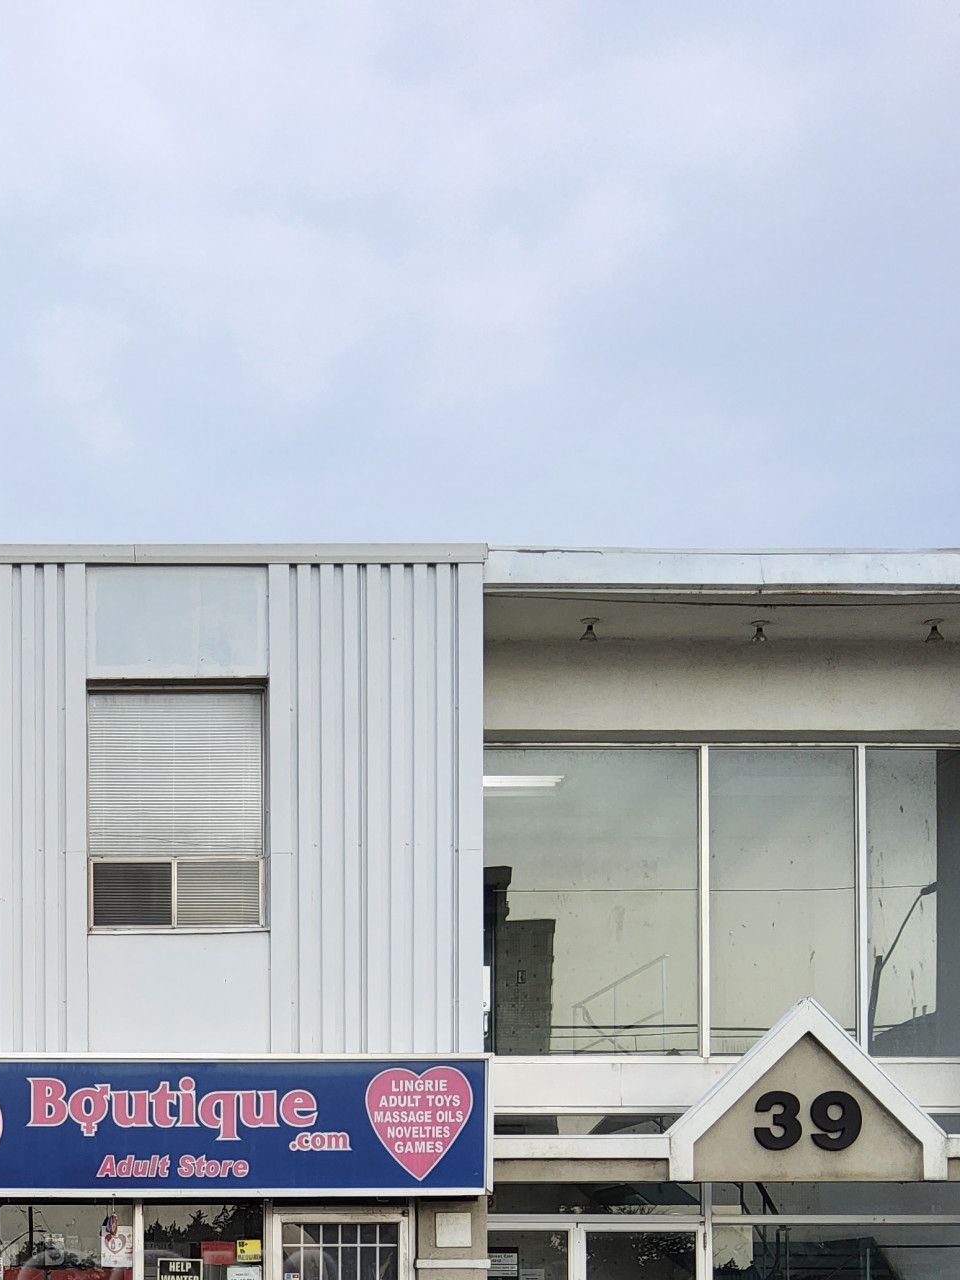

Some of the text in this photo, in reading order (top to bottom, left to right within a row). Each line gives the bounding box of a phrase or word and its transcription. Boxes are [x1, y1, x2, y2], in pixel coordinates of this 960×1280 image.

[391, 1079, 448, 1092] LINGRIE
[379, 1094, 461, 1108] ADULT TOYS
[25, 1075, 320, 1142] Boutique
[373, 1110, 464, 1124] MASSAGE OILS
[753, 1090, 863, 1151] 39
[387, 1126, 451, 1139] NOVELTIES
[288, 1130, 353, 1152] .com
[394, 1141, 444, 1154] GAMES
[95, 1153, 250, 1179] Adult Store
[168, 1261, 192, 1273] HELP
